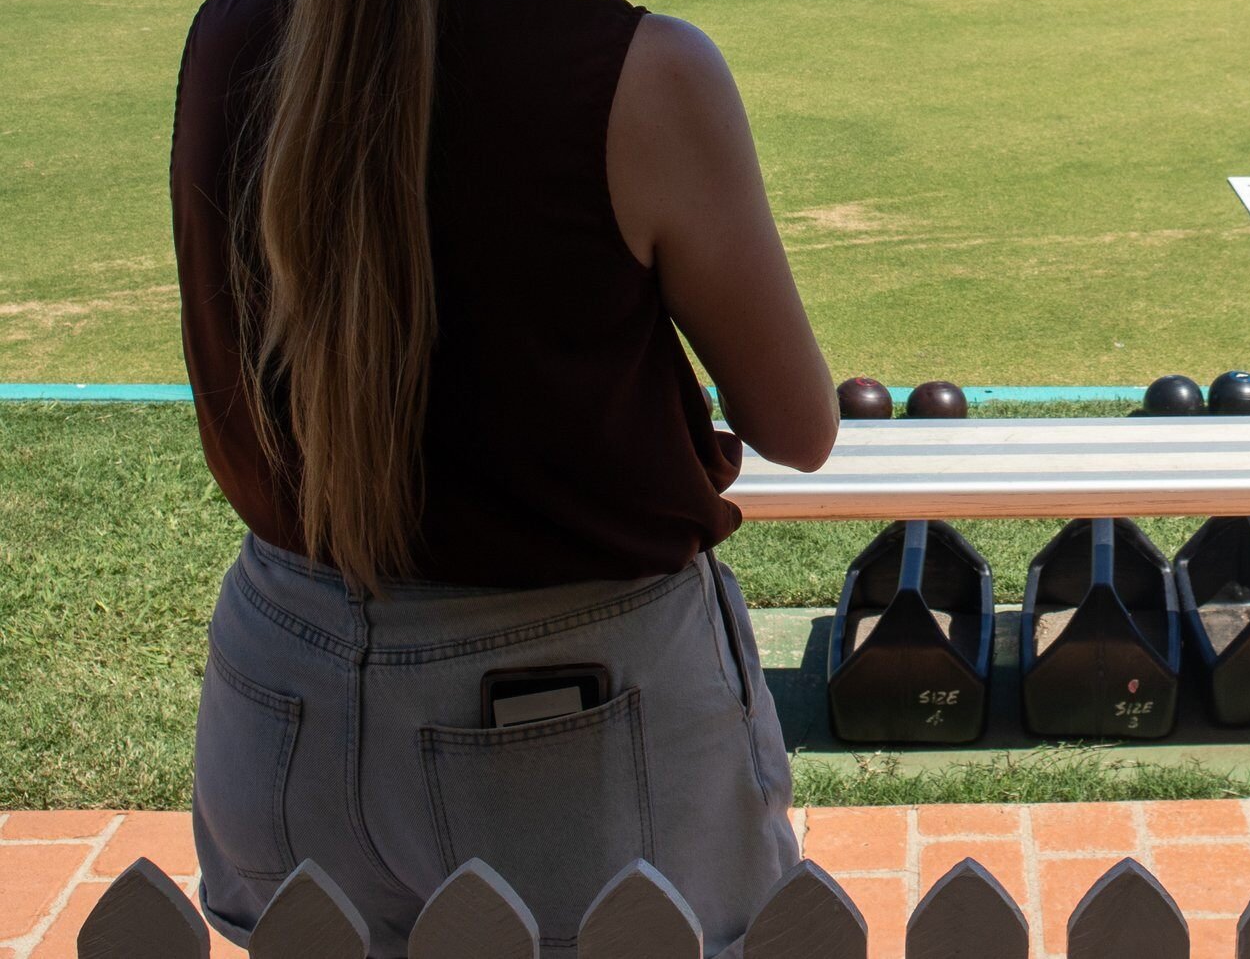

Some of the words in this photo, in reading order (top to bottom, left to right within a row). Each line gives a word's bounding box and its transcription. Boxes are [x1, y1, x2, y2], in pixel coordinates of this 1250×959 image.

[919, 690, 960, 705] SIZE
[1114, 701, 1154, 716] SIZE
[1127, 716, 1139, 729] 3
